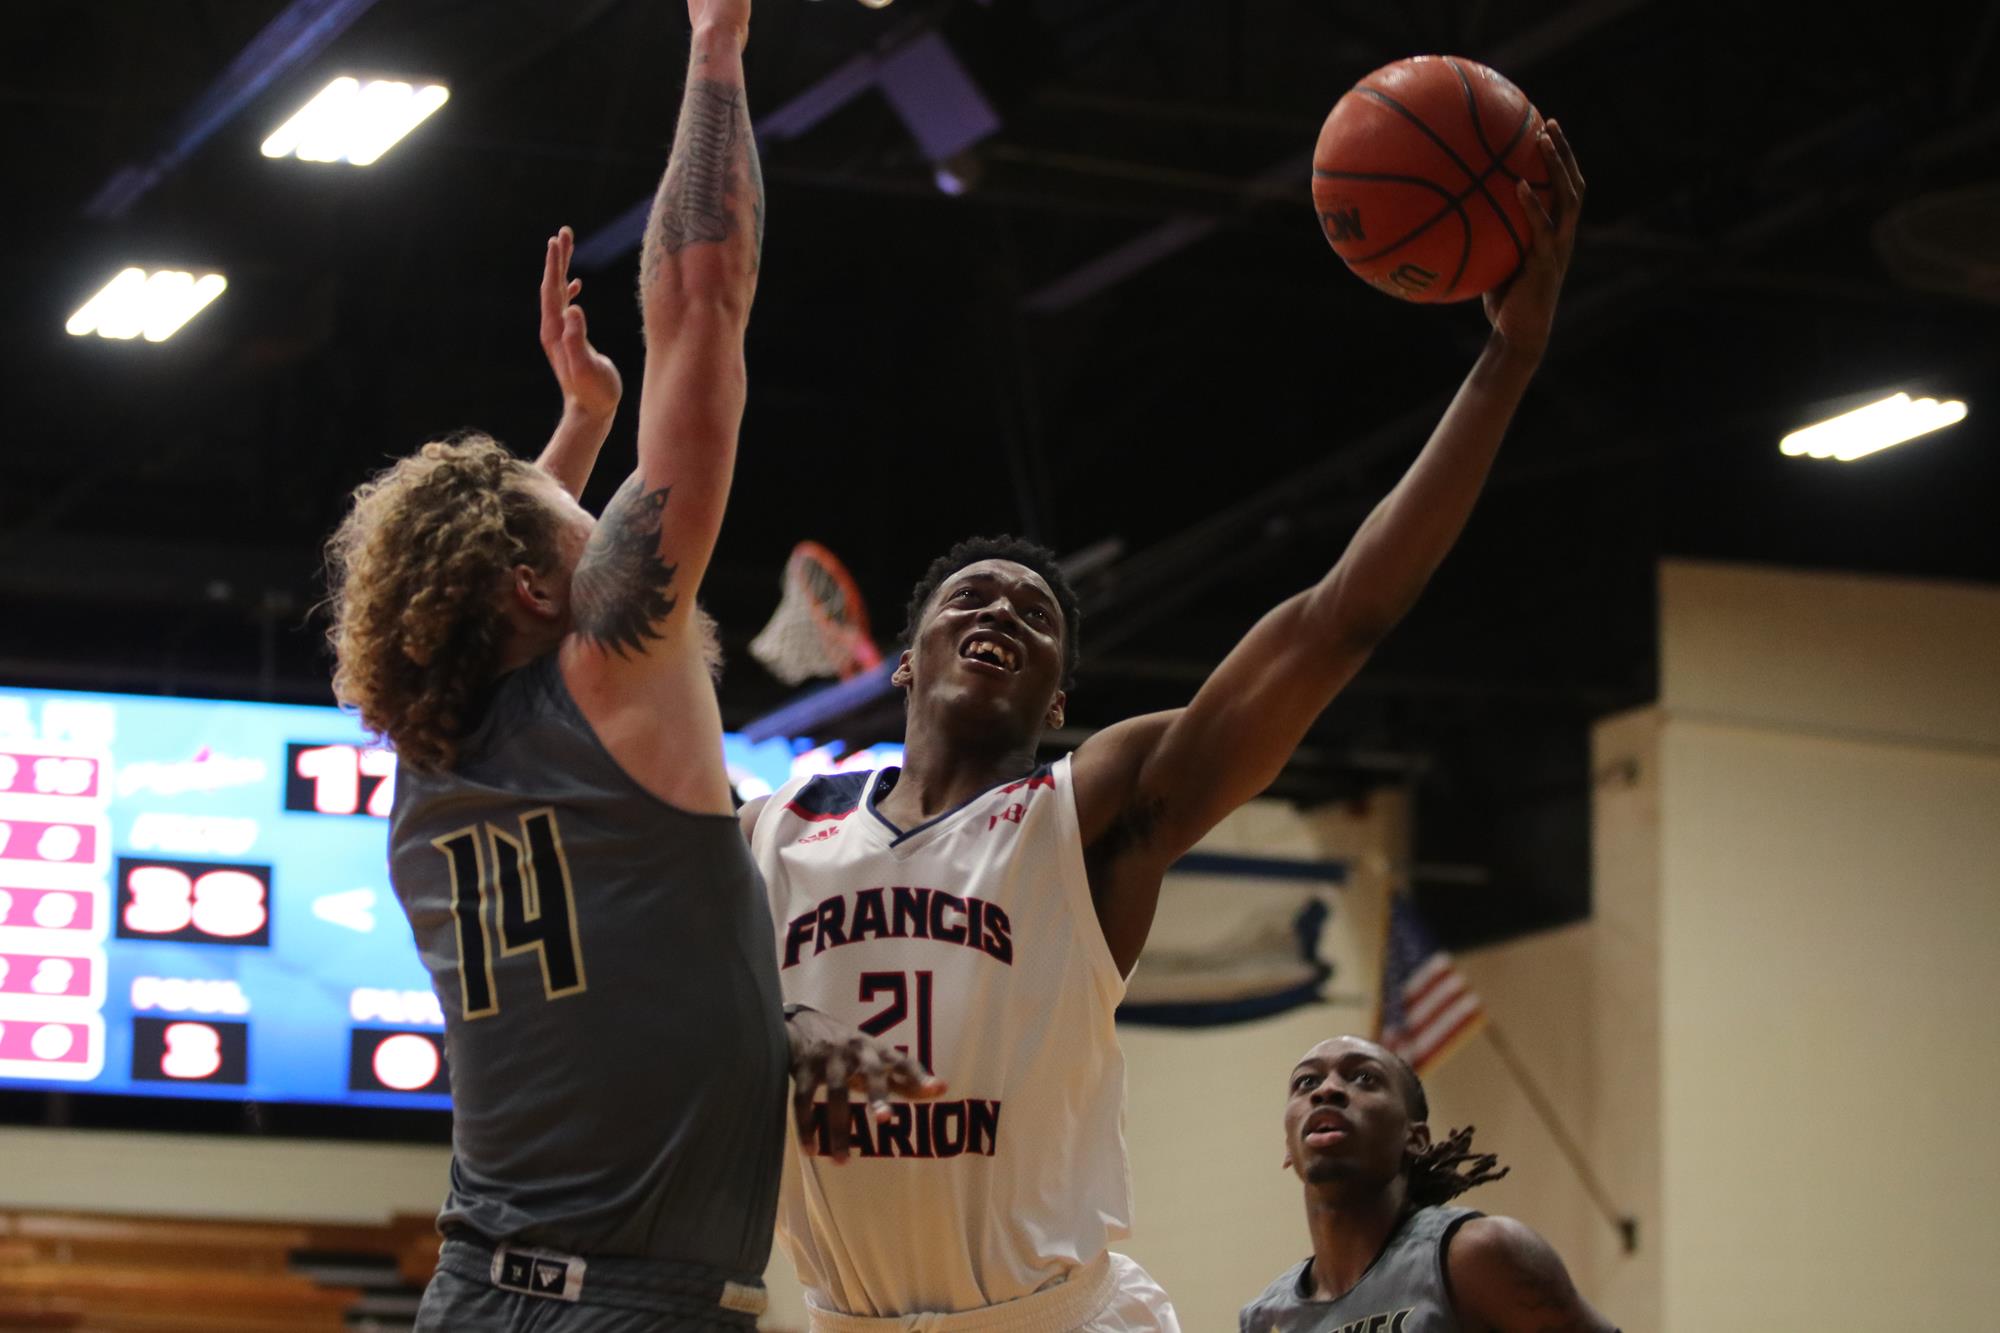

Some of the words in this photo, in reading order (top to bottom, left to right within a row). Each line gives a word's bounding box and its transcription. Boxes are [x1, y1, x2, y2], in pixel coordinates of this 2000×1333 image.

[430, 806, 587, 1021] 14
[782, 887, 1013, 970] FRANCIS
[858, 971, 934, 1076] 21
